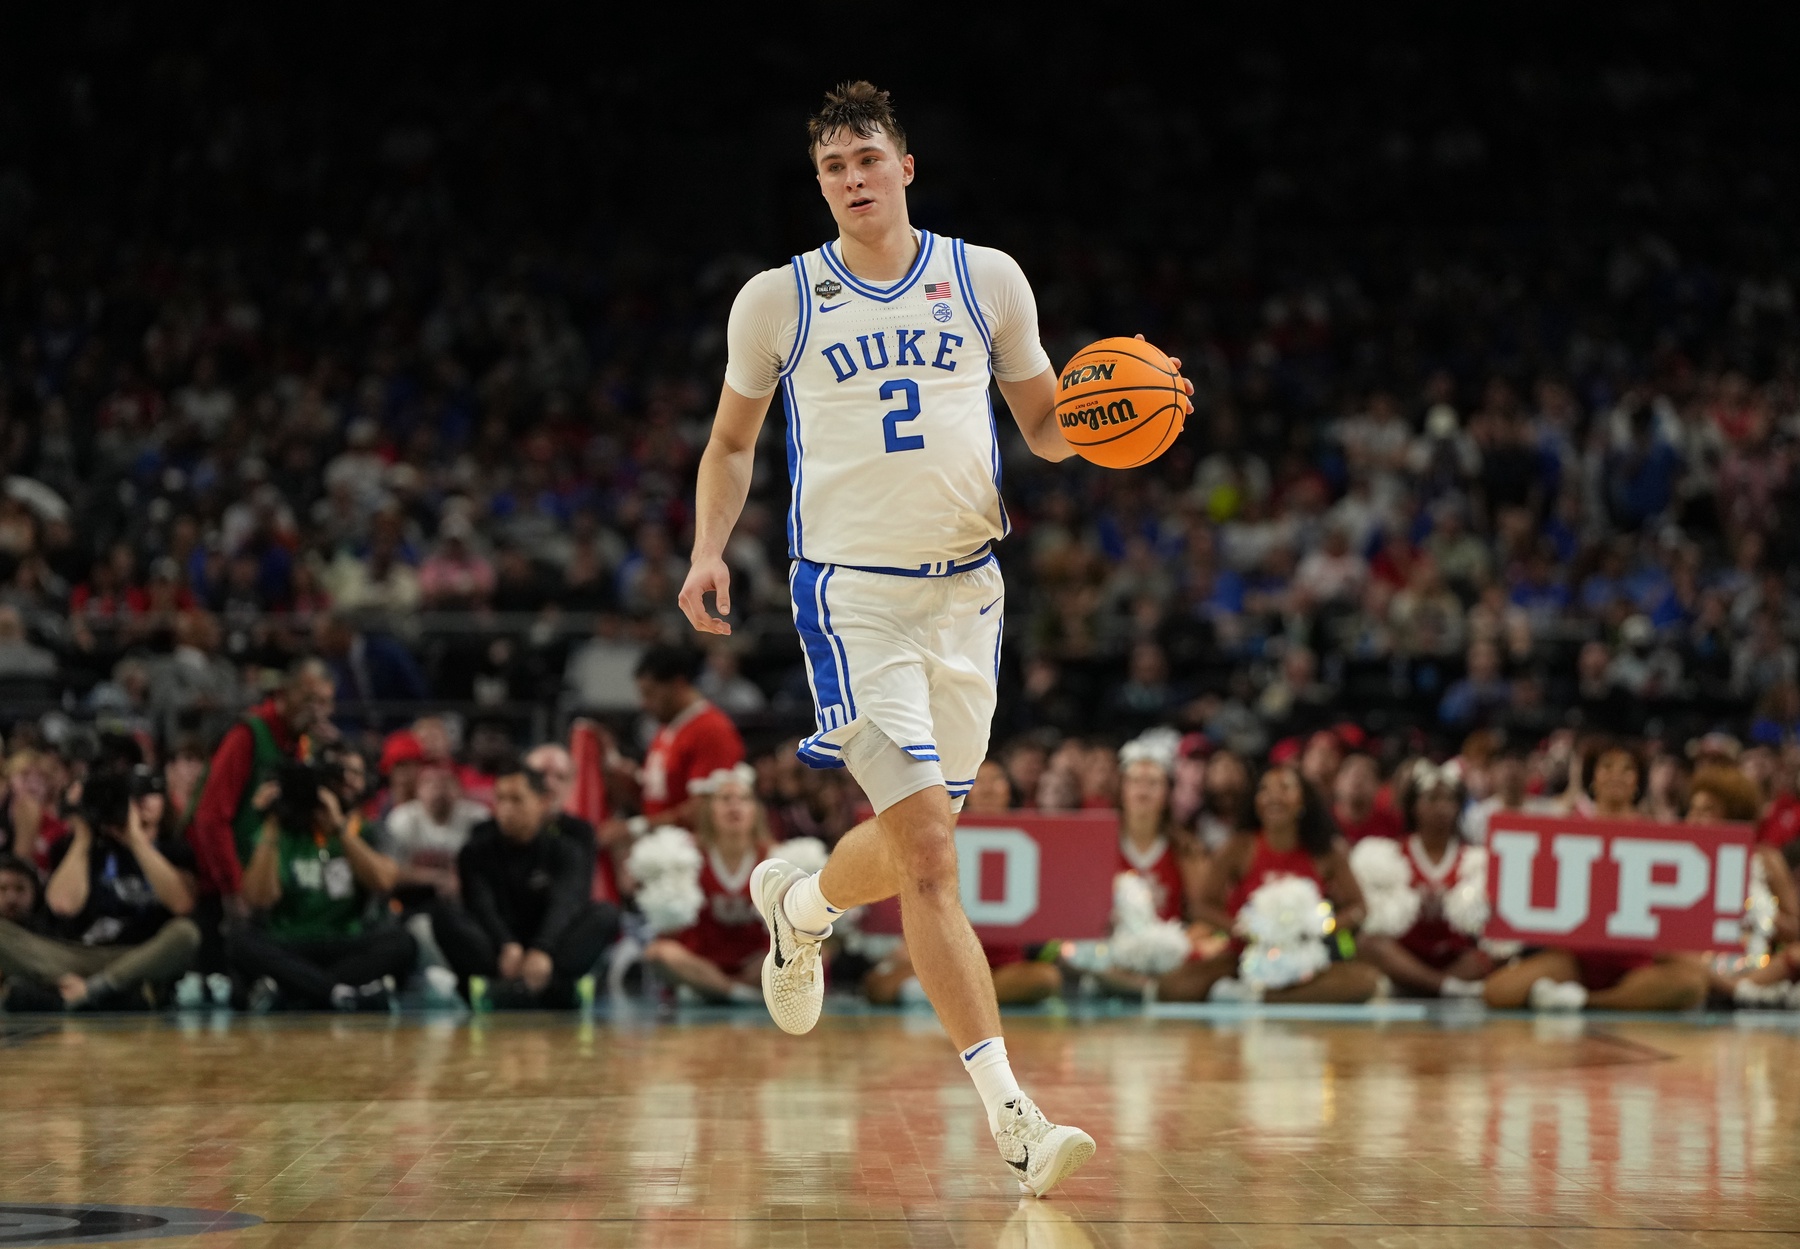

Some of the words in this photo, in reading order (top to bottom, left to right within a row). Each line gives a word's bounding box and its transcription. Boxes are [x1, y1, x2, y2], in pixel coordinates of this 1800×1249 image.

[822, 329, 963, 383] DUKE
[1062, 363, 1116, 391] NCAA
[879, 378, 925, 453] 2
[1059, 398, 1139, 431] Wilson
[1491, 830, 1748, 944] UP!
